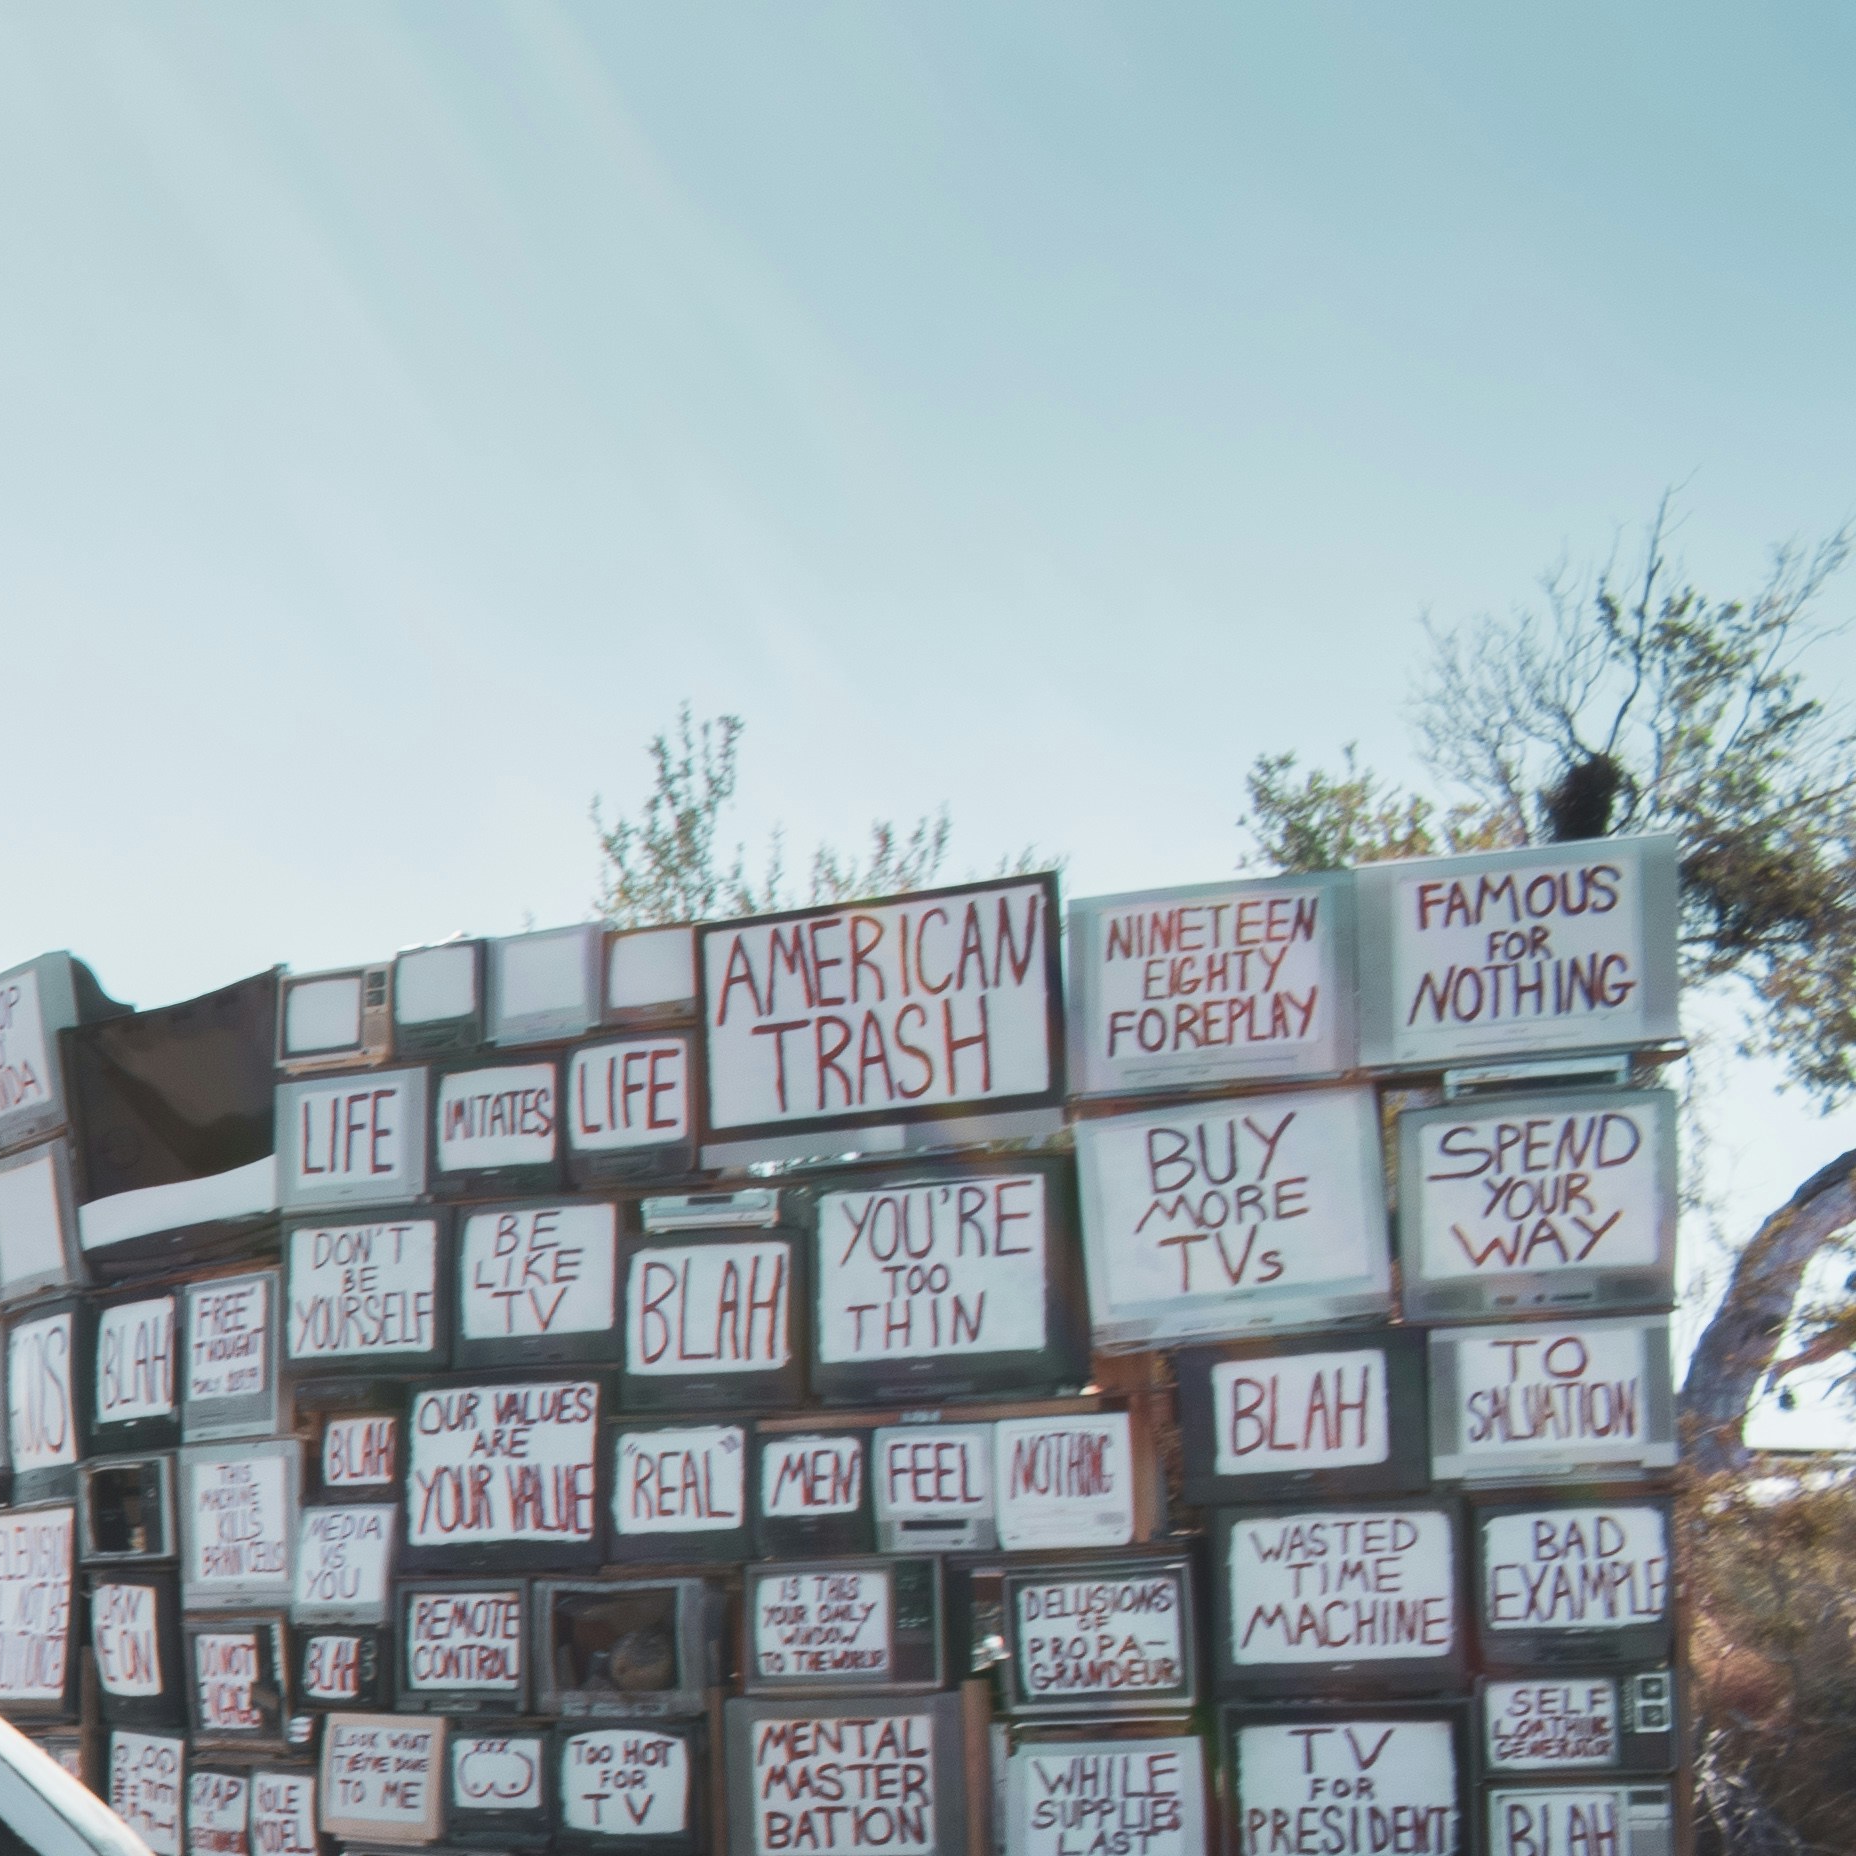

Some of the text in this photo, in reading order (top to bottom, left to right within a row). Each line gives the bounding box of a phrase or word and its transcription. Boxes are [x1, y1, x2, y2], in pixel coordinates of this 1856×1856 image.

[1416, 864, 1621, 929] FAMOUS
[1105, 897, 1317, 961] NINETEEN
[1488, 925, 1551, 961] FOR
[716, 894, 1038, 1025] AMERICAN
[1144, 948, 1289, 1000] EIGHTY
[1406, 953, 1636, 1028] NOTHING
[1106, 985, 1318, 1058] FOREPLAY
[752, 1006, 993, 1114] TRASH
[577, 1047, 682, 1135] LIFE
[300, 1088, 398, 1176] LIFE
[444, 1086, 555, 1144] IMITATES
[1148, 1112, 1296, 1194] BUY
[1425, 1112, 1642, 1182] SPEND
[1134, 1178, 1310, 1234] MORE
[1485, 1170, 1595, 1219] YOUR
[313, 1225, 405, 1266] DON'T
[495, 1212, 562, 1253] BE
[841, 1180, 1033, 1266] YOU'RE
[1448, 1210, 1623, 1269] WAY
[342, 1265, 377, 1291] BE
[474, 1249, 583, 1290] LIKE
[882, 1261, 950, 1297] TOO
[1160, 1226, 1285, 1292] TVs
[294, 1290, 435, 1351] YOURSELF
[491, 1286, 571, 1334] TV
[640, 1242, 787, 1364] BLAH
[844, 1294, 985, 1353] THIN
[103, 1306, 173, 1410] BLAH
[1489, 1337, 1588, 1382] TO
[418, 1387, 594, 1434] OUR VALUES
[1230, 1364, 1369, 1457] BLAH
[1468, 1376, 1641, 1443] SALVATION
[328, 1419, 394, 1480] BLAH
[470, 1428, 532, 1459] ARE
[1010, 1432, 1113, 1499] NOTHING
[771, 1450, 861, 1507] MEN
[889, 1442, 983, 1503] FEEL
[416, 1463, 594, 1534] YOUR VALUE
[307, 1514, 383, 1541] MEDIA
[1250, 1518, 1419, 1563] WASTED
[1533, 1515, 1628, 1562] BAD
[319, 1541, 347, 1568] VS
[1286, 1557, 1405, 1599] TIME
[306, 1567, 361, 1599] YOU
[779, 1574, 860, 1602] IS THIS
[1023, 1584, 1173, 1621] DELUSIONS
[1490, 1558, 1664, 1622] EXAMPLE
[415, 1600, 519, 1640] REMOTE
[763, 1602, 878, 1630] YOUR ONLY
[1077, 1614, 1107, 1632] OF
[1242, 1597, 1449, 1649] MACHINE
[304, 1638, 360, 1693] BLAH
[414, 1643, 519, 1681] CONTROL
[760, 1651, 785, 1673] TO
[1030, 1660, 1178, 1690] GRANDEUR
[1509, 1688, 1612, 1716] SELF
[334, 1731, 379, 1751] LOOK
[570, 1739, 676, 1767] TOO HOT
[758, 1718, 928, 1766] MENTAL
[1289, 1727, 1395, 1774] TV
[339, 1779, 421, 1809] TO ME
[599, 1770, 647, 1789] FOR
[762, 1762, 929, 1805] MASTER
[1033, 1752, 1178, 1798] WHILE
[1310, 1777, 1375, 1801] FOR
[583, 1793, 654, 1825] TV
[764, 1805, 926, 1849] BATION
[1033, 1800, 1182, 1832] SUPPLIES
[1246, 1806, 1452, 1856] PRESIDENT
[1057, 1828, 1157, 1856] LAST
